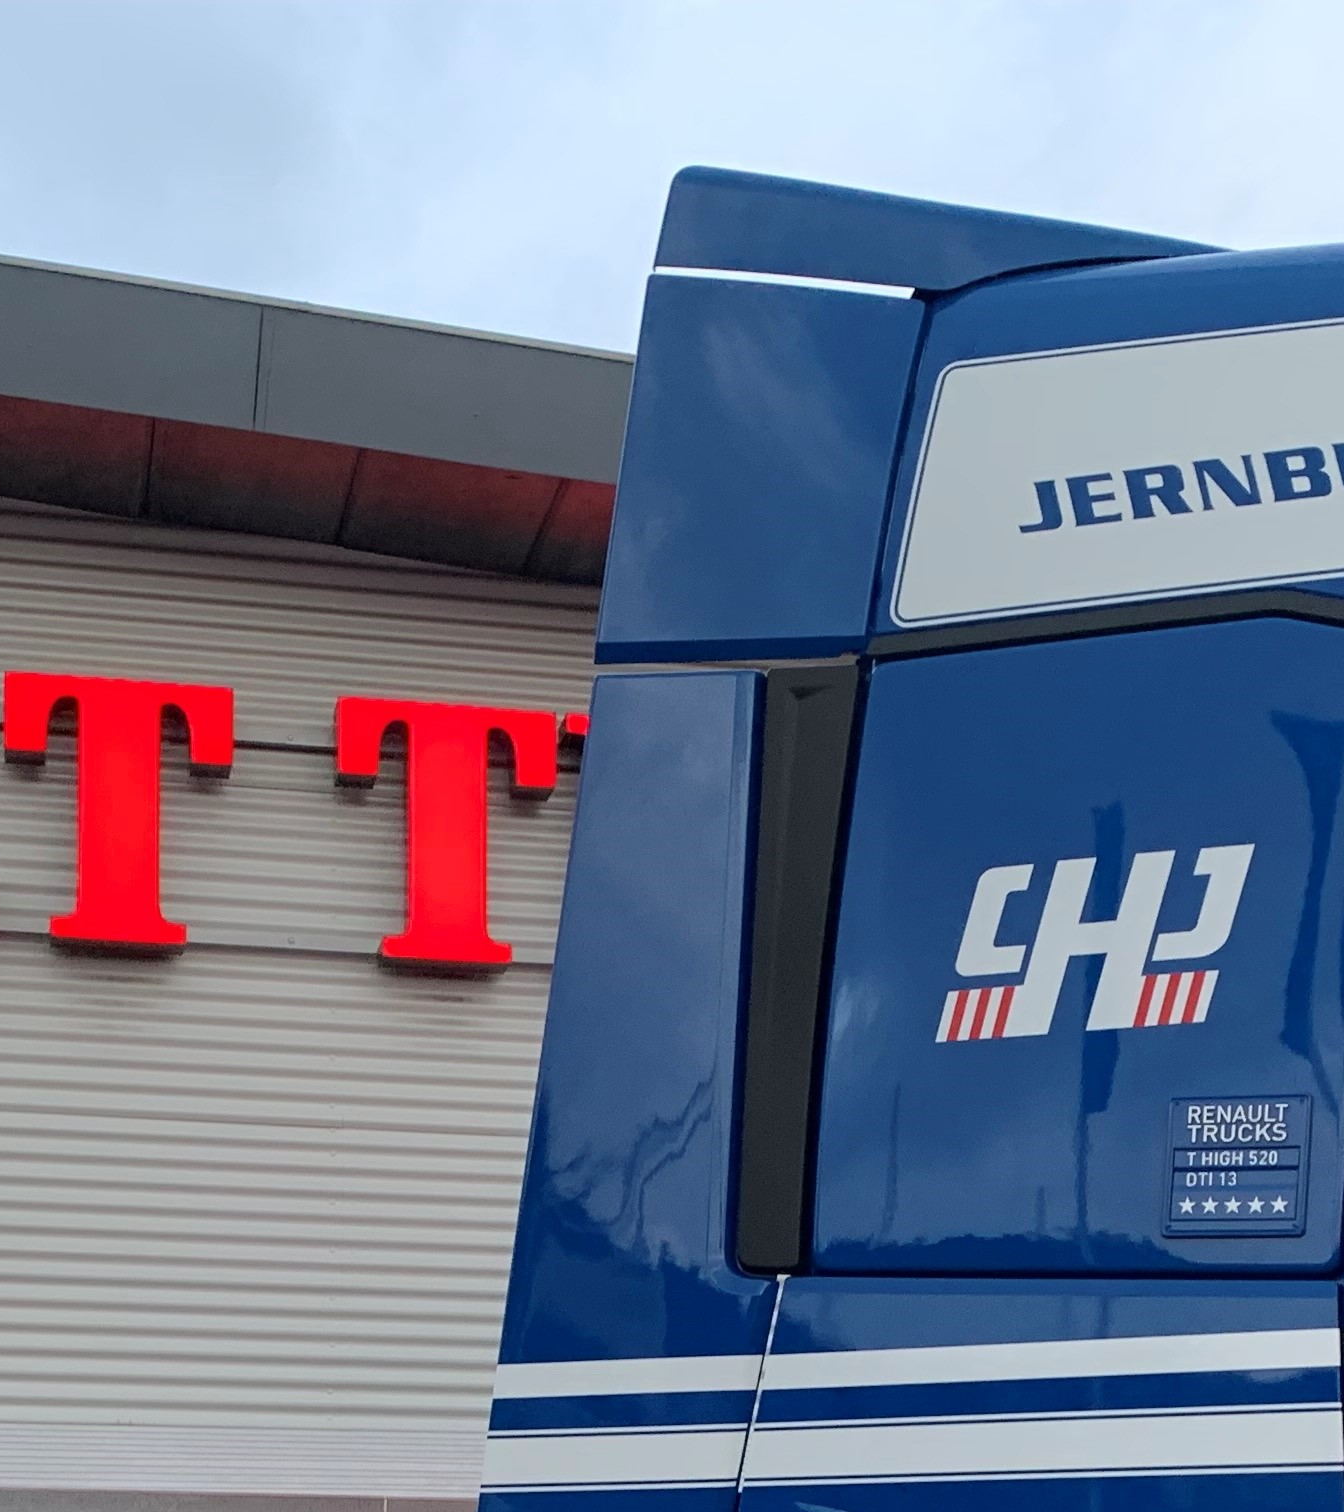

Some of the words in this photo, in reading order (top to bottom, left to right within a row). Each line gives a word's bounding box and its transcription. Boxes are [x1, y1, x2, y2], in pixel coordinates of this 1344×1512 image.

[935, 843, 1255, 1043] CHJ
[1187, 1103, 1288, 1123] RENAULT
[1187, 1123, 1287, 1143] TRUCKS
[1187, 1152, 1196, 1166] T
[1201, 1151, 1244, 1166] HIGH
[1249, 1150, 1278, 1165] 520
[1186, 1171, 1213, 1187] DTI
[1219, 1171, 1237, 1186] 13
